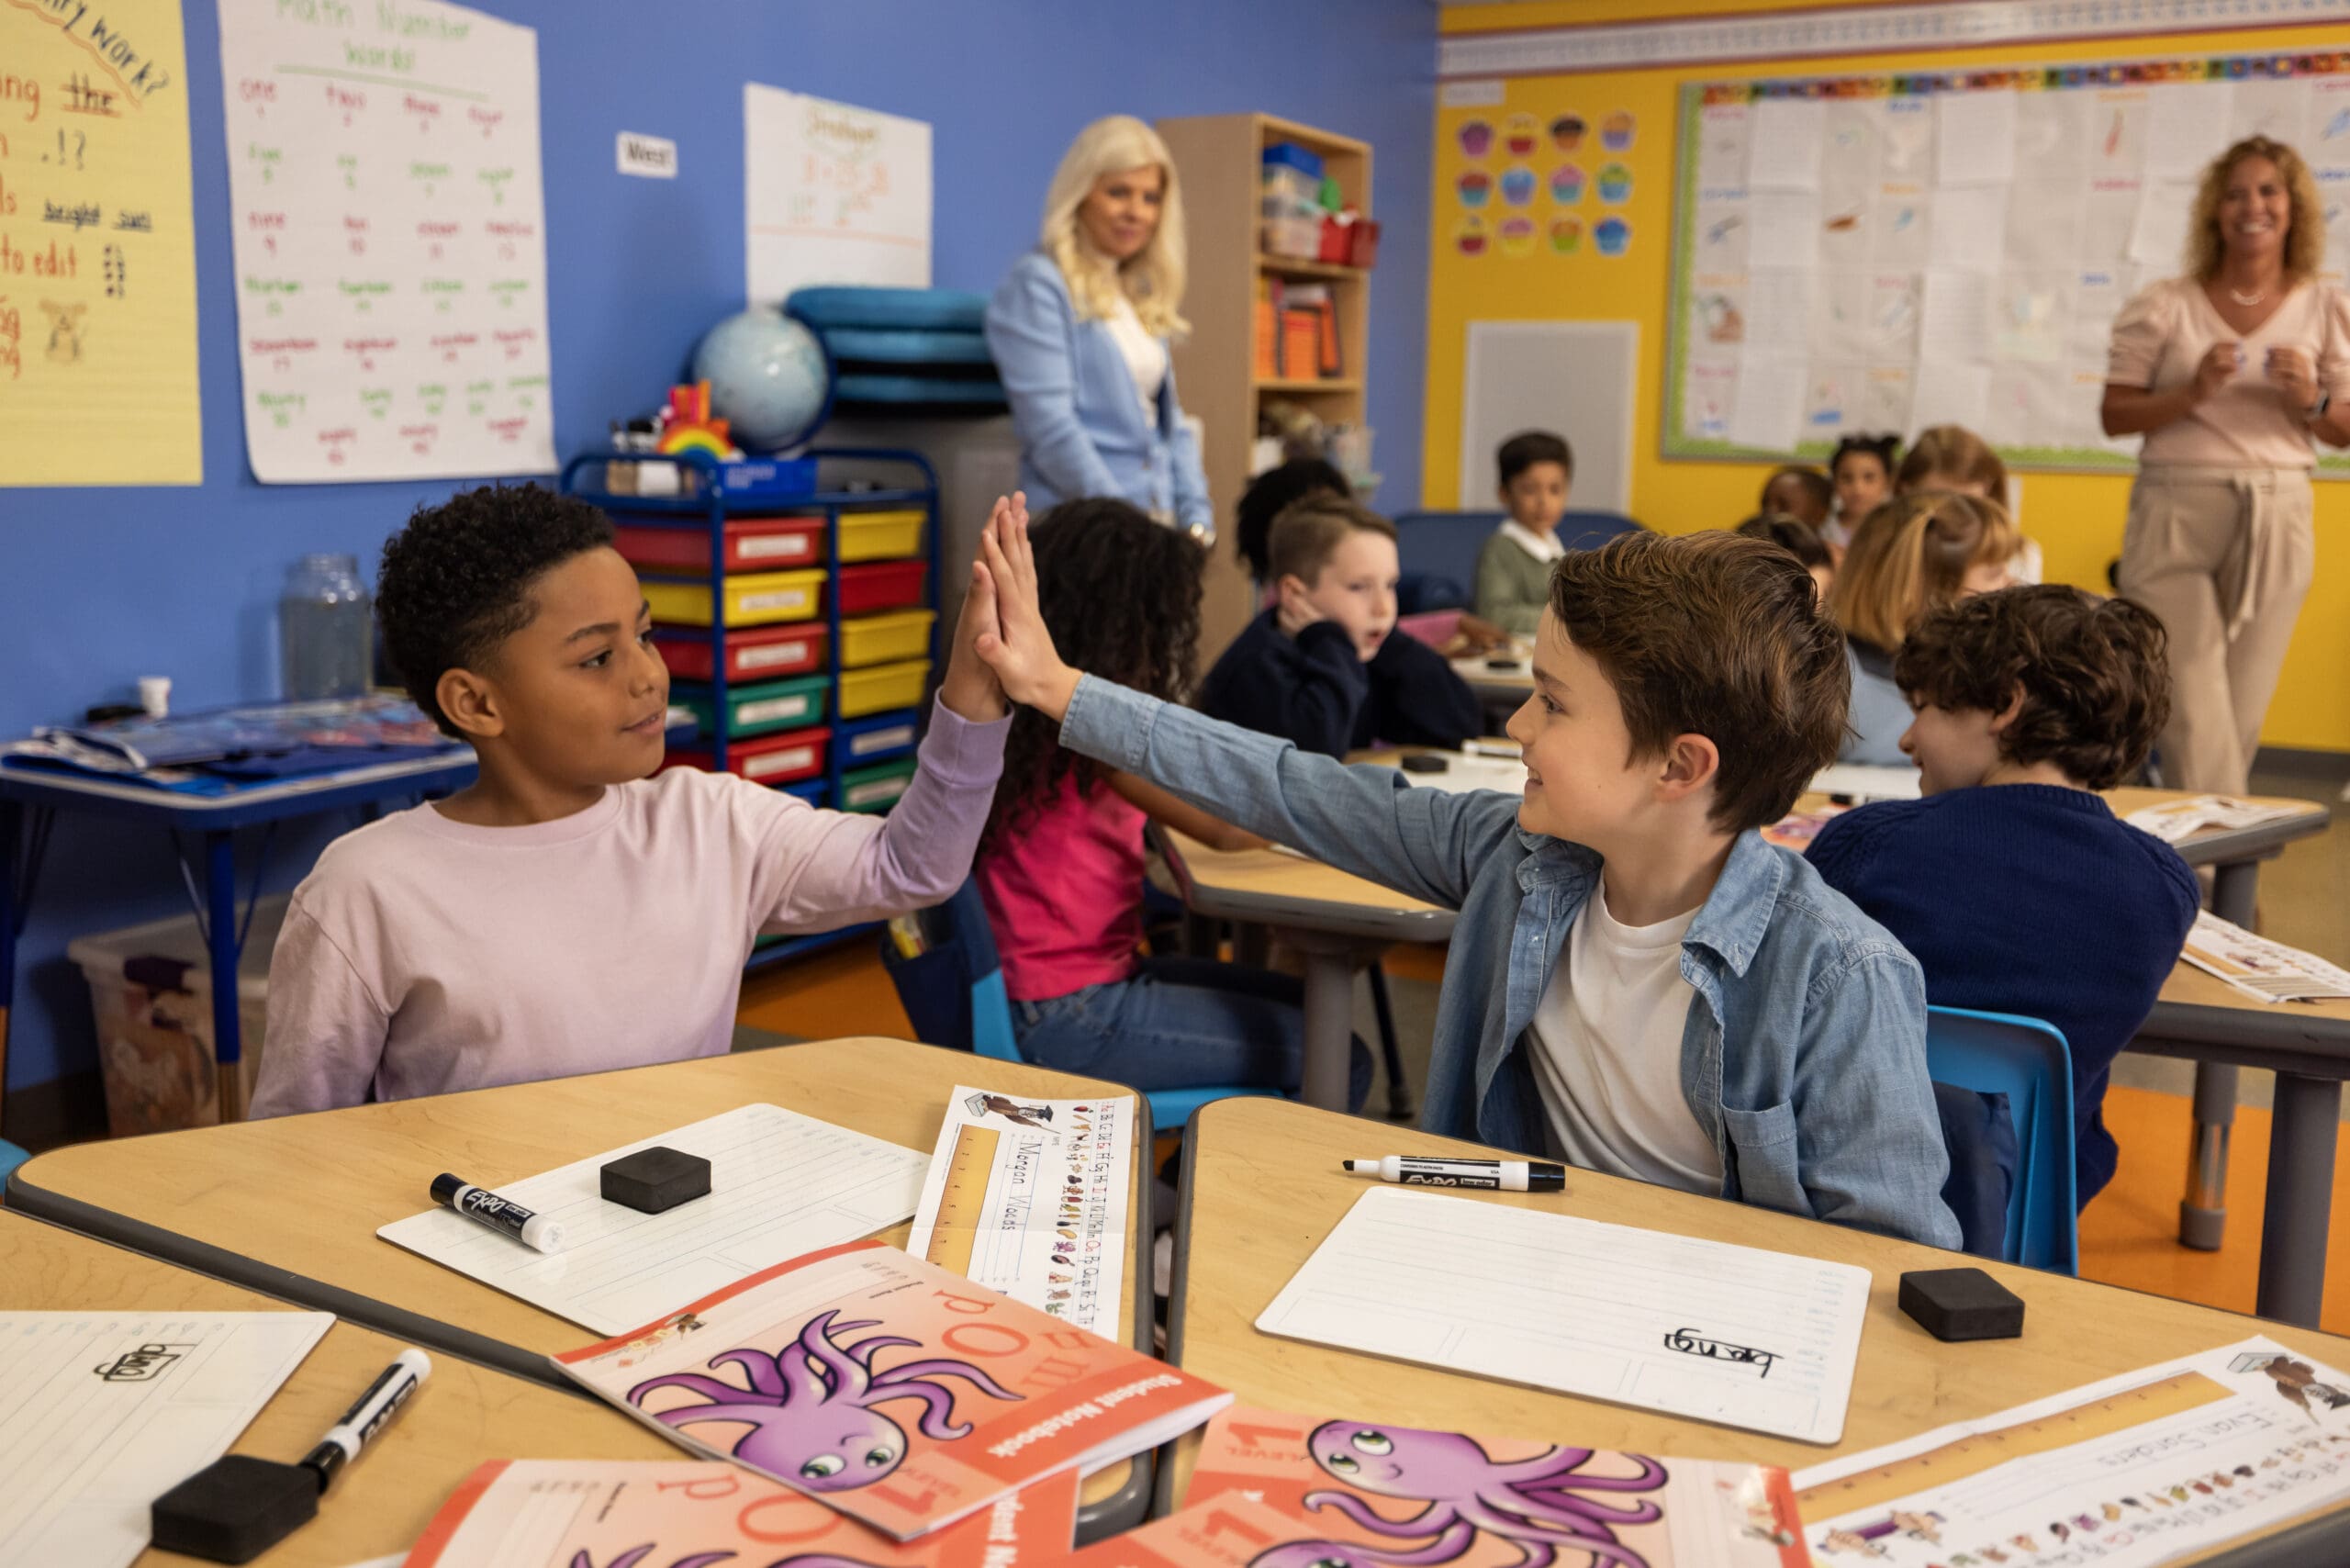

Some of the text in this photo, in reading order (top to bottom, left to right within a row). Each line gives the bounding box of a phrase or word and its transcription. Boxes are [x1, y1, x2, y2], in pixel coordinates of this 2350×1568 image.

[1, 234, 24, 274] to
[34, 239, 77, 279] edit
[465, 1191, 506, 1214] EXPO
[1002, 1142, 1042, 1230] Morgan Woods
[987, 1373, 1182, 1458] Student Notebook
[2097, 1412, 2274, 1466] Evan Sanders
